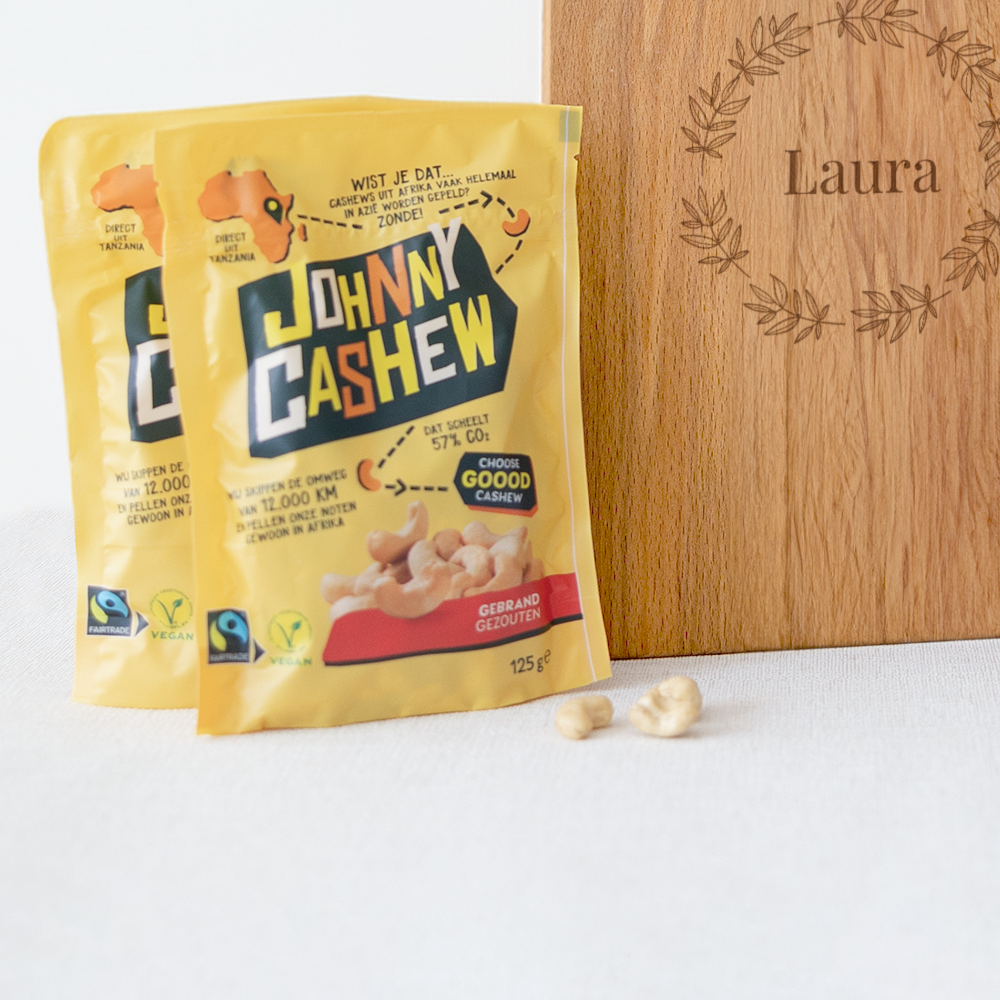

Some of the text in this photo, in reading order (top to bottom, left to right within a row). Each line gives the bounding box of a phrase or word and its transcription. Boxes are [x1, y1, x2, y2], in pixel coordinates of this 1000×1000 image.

[351, 173, 386, 192] WIST
[394, 170, 409, 186] JE
[784, 149, 942, 195] Laura
[328, 169, 517, 209] CASHEWS UIT AFRIKA VAAK HELEMAAL
[344, 208, 354, 219] IN
[382, 196, 425, 212] WORDEN
[428, 186, 470, 203] GEPELD?
[378, 207, 424, 228] ZONDE!
[105, 224, 136, 233] DIRECT
[215, 232, 246, 243] DIRECT
[99, 242, 145, 251] TANZANIA
[208, 253, 256, 263] TANZANIA
[264, 217, 463, 348] JOHNNY
[254, 293, 497, 444] CASHEW
[424, 413, 490, 436] DAT SCHEELT
[431, 432, 462, 451] 57%
[131, 464, 166, 480] SKIPPEN
[170, 461, 184, 474] DE
[478, 457, 520, 469] CHOOSE
[124, 474, 190, 498] VAN 12.000
[288, 477, 302, 489] DE
[306, 468, 347, 486] OMWEG
[461, 469, 531, 490] GOOOD
[130, 498, 167, 513] PELLEN
[170, 493, 191, 506] ONZ
[240, 484, 338, 516] VAN 12.000 KM
[475, 490, 523, 504] CASHEW
[127, 509, 171, 526] GEWOON
[174, 507, 185, 518] IN
[247, 514, 286, 530] PELLEN
[289, 508, 316, 522] ONZE
[321, 500, 357, 516] NOTEN
[246, 516, 345, 544] GEWOON IN AFRIKA
[478, 592, 540, 617] GEBRAND
[475, 607, 541, 632] GEZOUTEN
[88, 626, 131, 635] FAIRTRADE
[151, 630, 194, 641] VEGAN
[210, 652, 249, 662] FAIRTRADE
[270, 656, 313, 666] VEGAN
